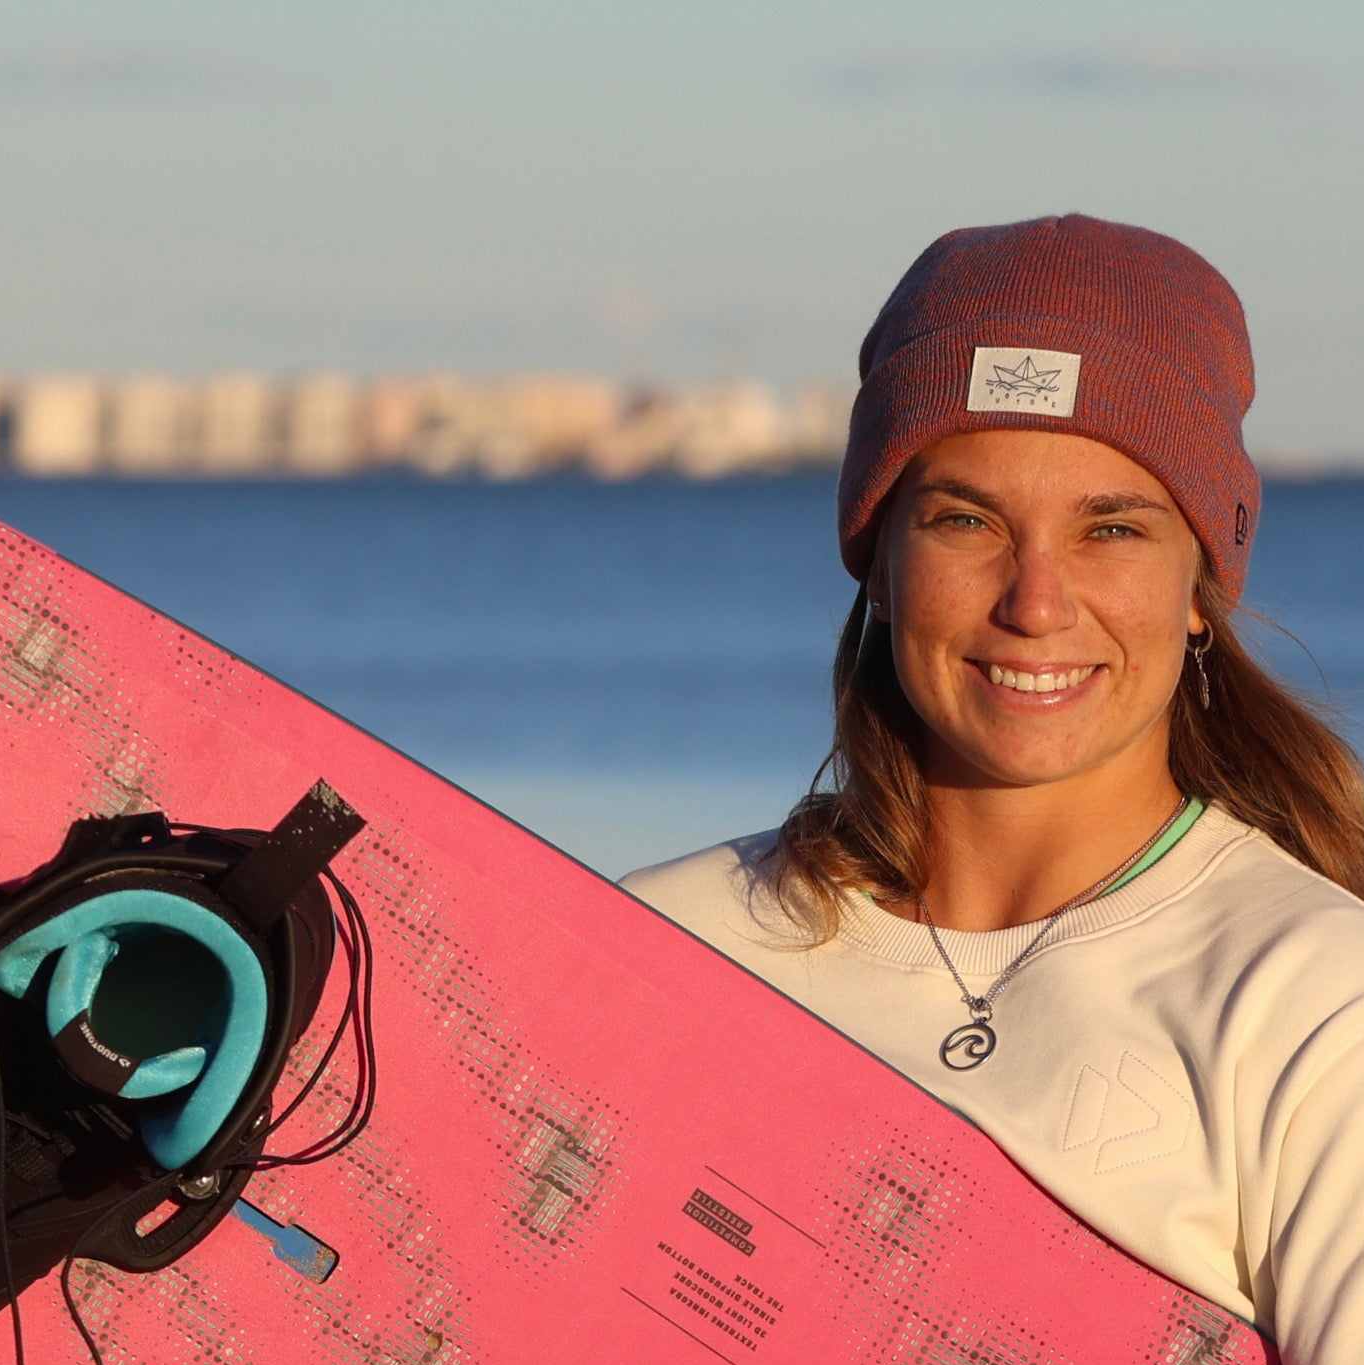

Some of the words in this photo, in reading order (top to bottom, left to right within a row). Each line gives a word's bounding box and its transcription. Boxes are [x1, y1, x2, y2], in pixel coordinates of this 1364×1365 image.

[79, 1021, 118, 1062] DUOTONE
[693, 1190, 750, 1233] FREESTYLE
[684, 1203, 753, 1254] COMPETITION
[657, 1241, 695, 1270] BOTTOM
[674, 1271, 724, 1309] WOODCORE
[696, 1267, 741, 1301] DIFFUSOR
[734, 1274, 764, 1299] TRACK
[724, 1307, 753, 1328] LIGHT
[742, 1299, 776, 1325] SINGLE
[766, 1296, 784, 1312] THE
[710, 1316, 757, 1352] TEXTREME
[754, 1326, 767, 1338] 3D
